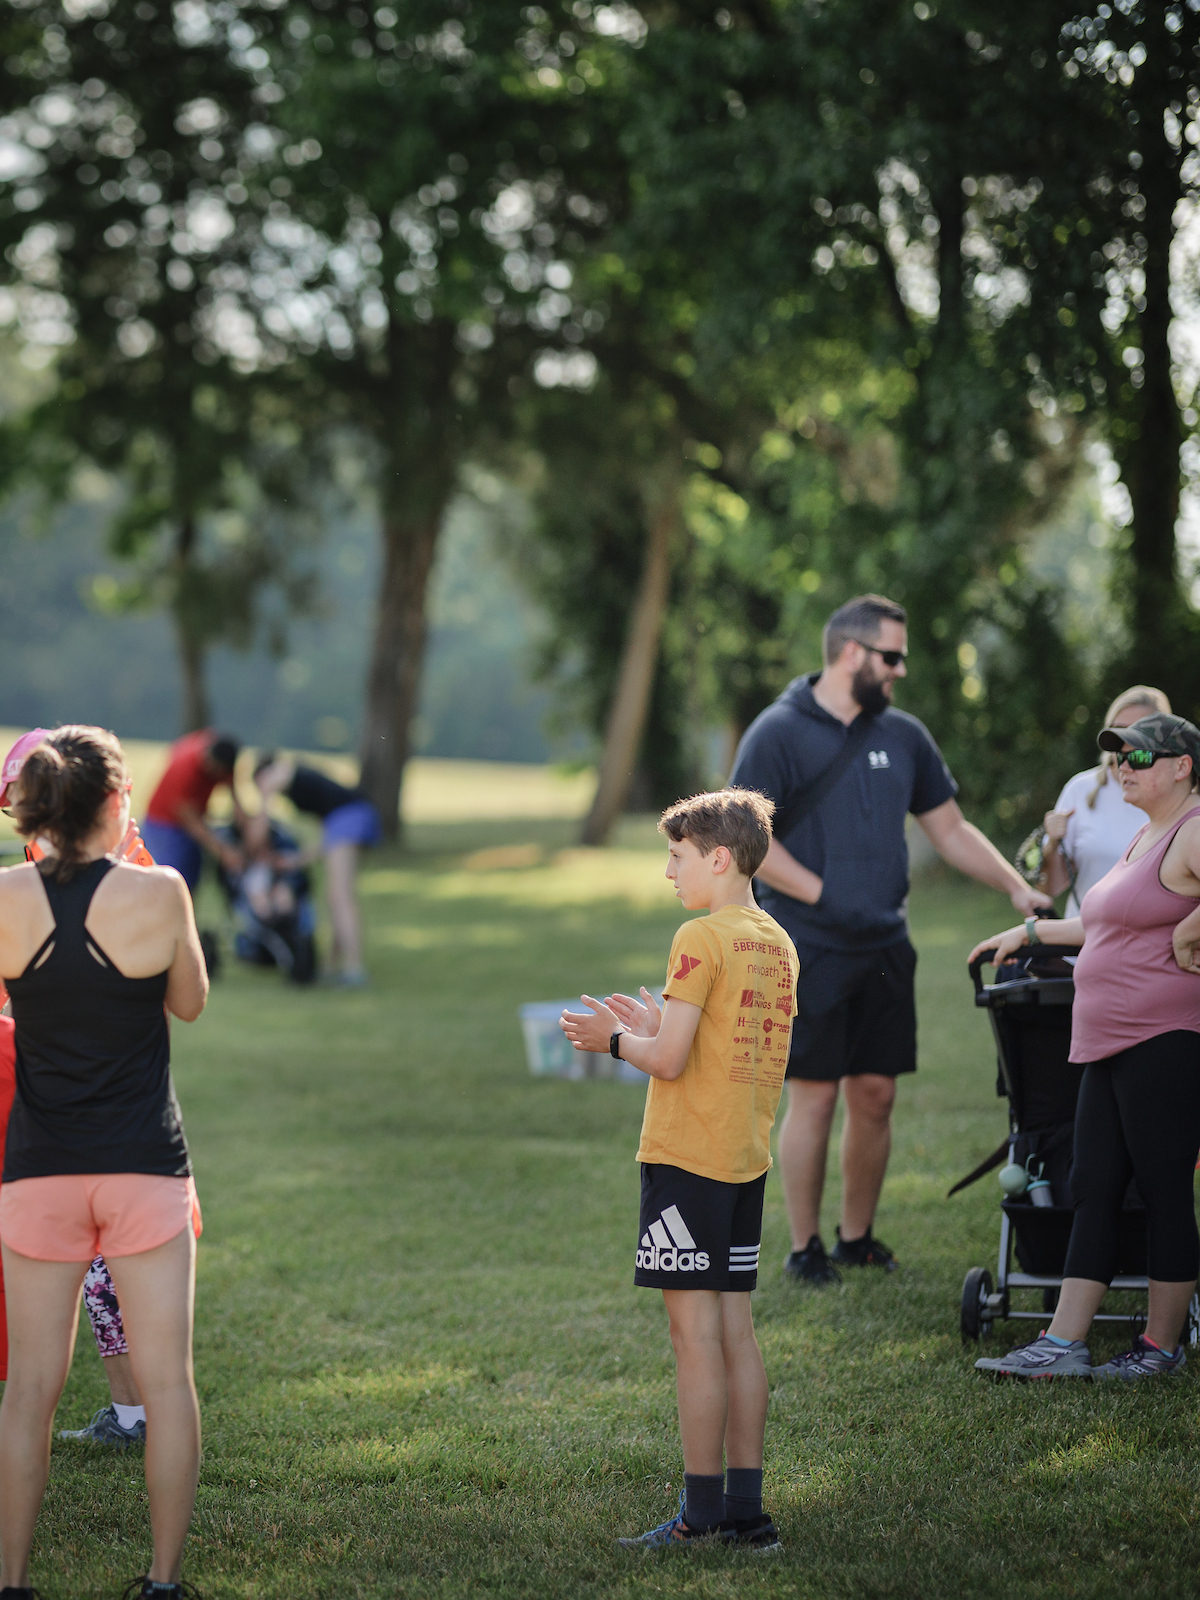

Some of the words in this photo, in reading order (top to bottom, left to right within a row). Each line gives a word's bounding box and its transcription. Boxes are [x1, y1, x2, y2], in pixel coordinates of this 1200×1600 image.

[733, 942, 739, 952] 5
[740, 941, 766, 954] BEFORE
[767, 944, 782, 956] THE
[635, 1245, 711, 1272] adidas
